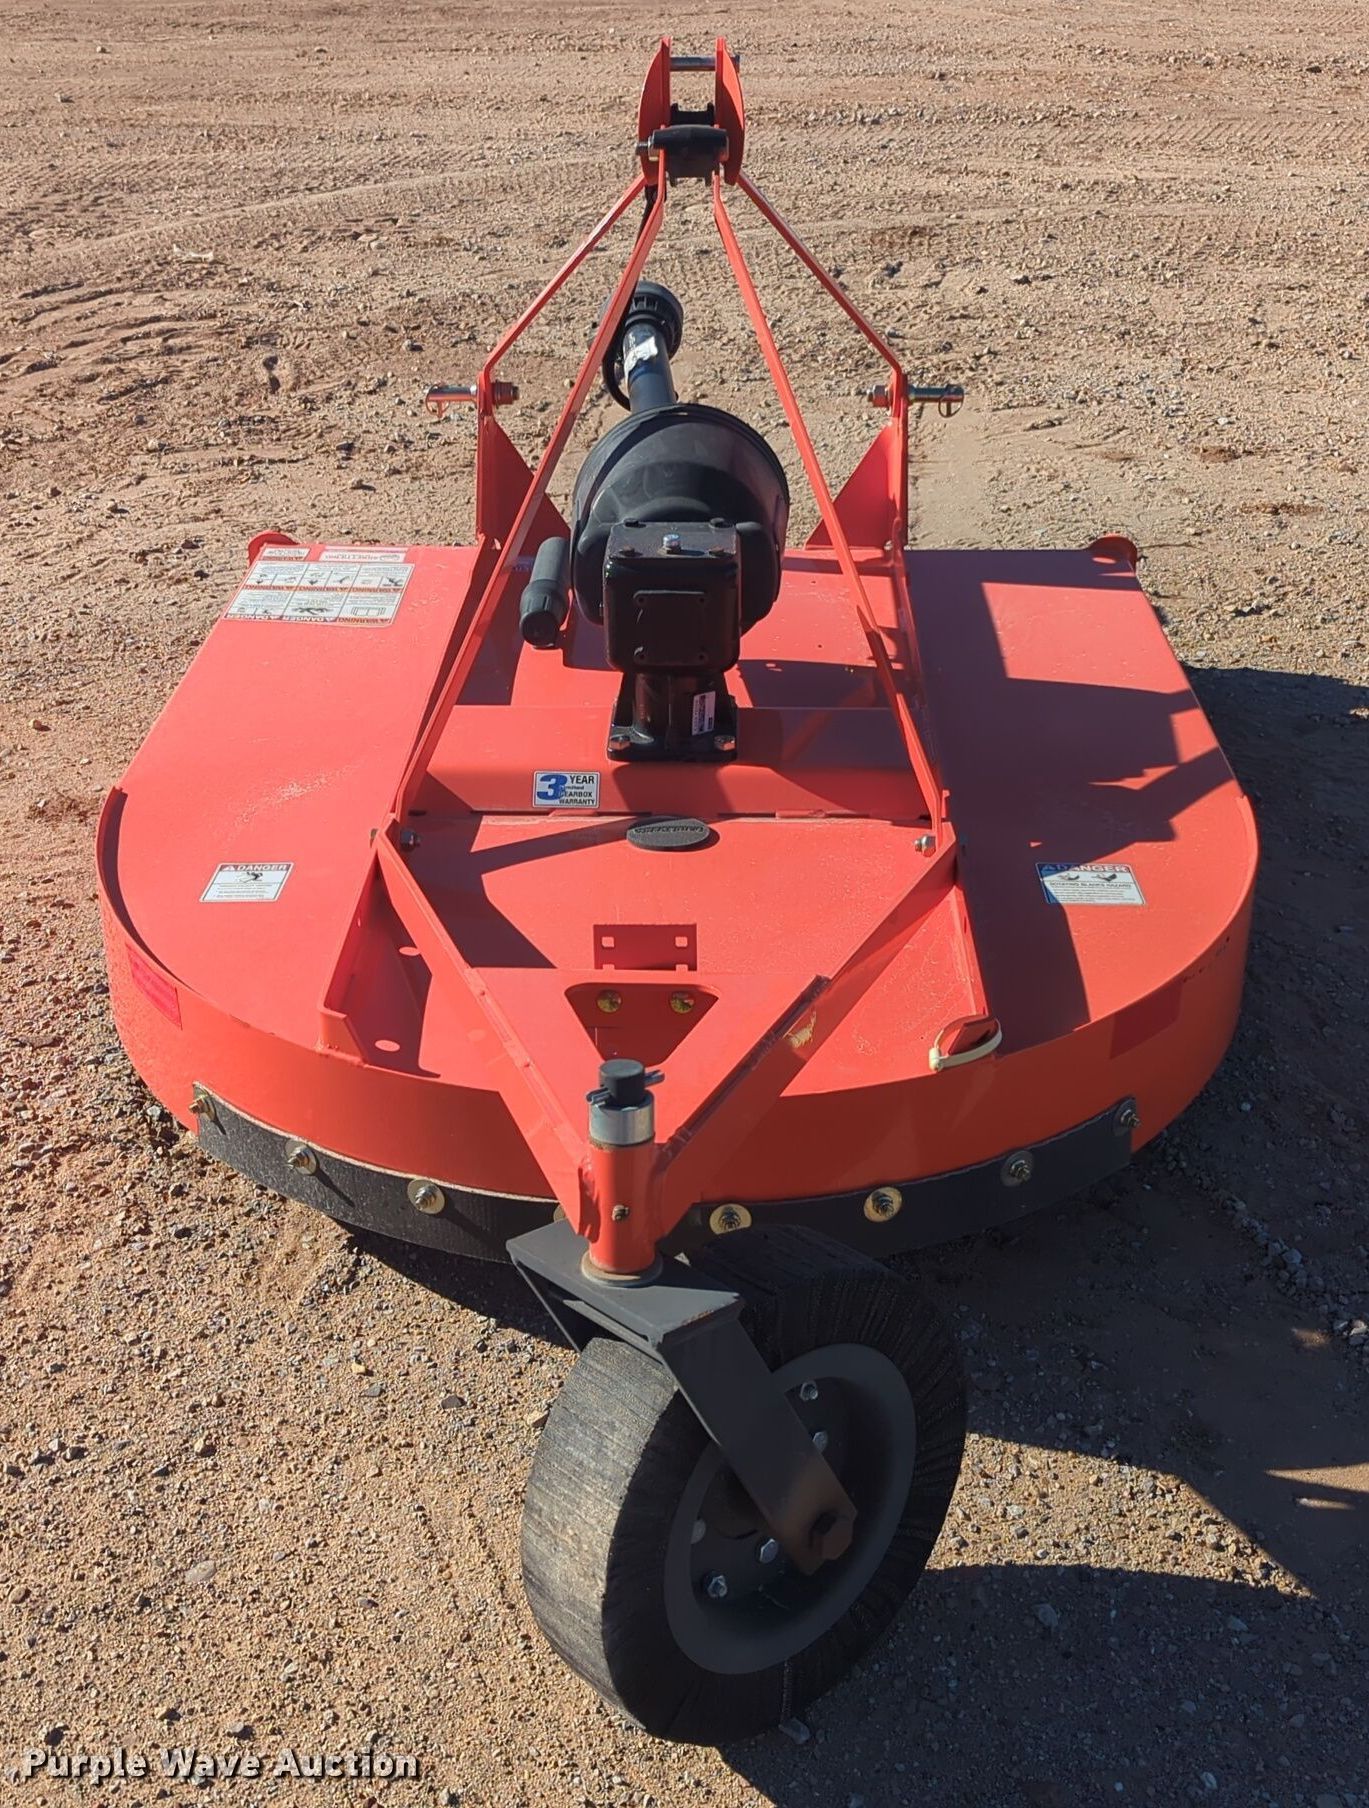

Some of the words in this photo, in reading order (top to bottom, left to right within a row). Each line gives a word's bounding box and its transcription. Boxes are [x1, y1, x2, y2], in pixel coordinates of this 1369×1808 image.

[537, 774, 568, 800] 3
[569, 775, 595, 784] YEAR
[1056, 864, 1127, 872] DANGER
